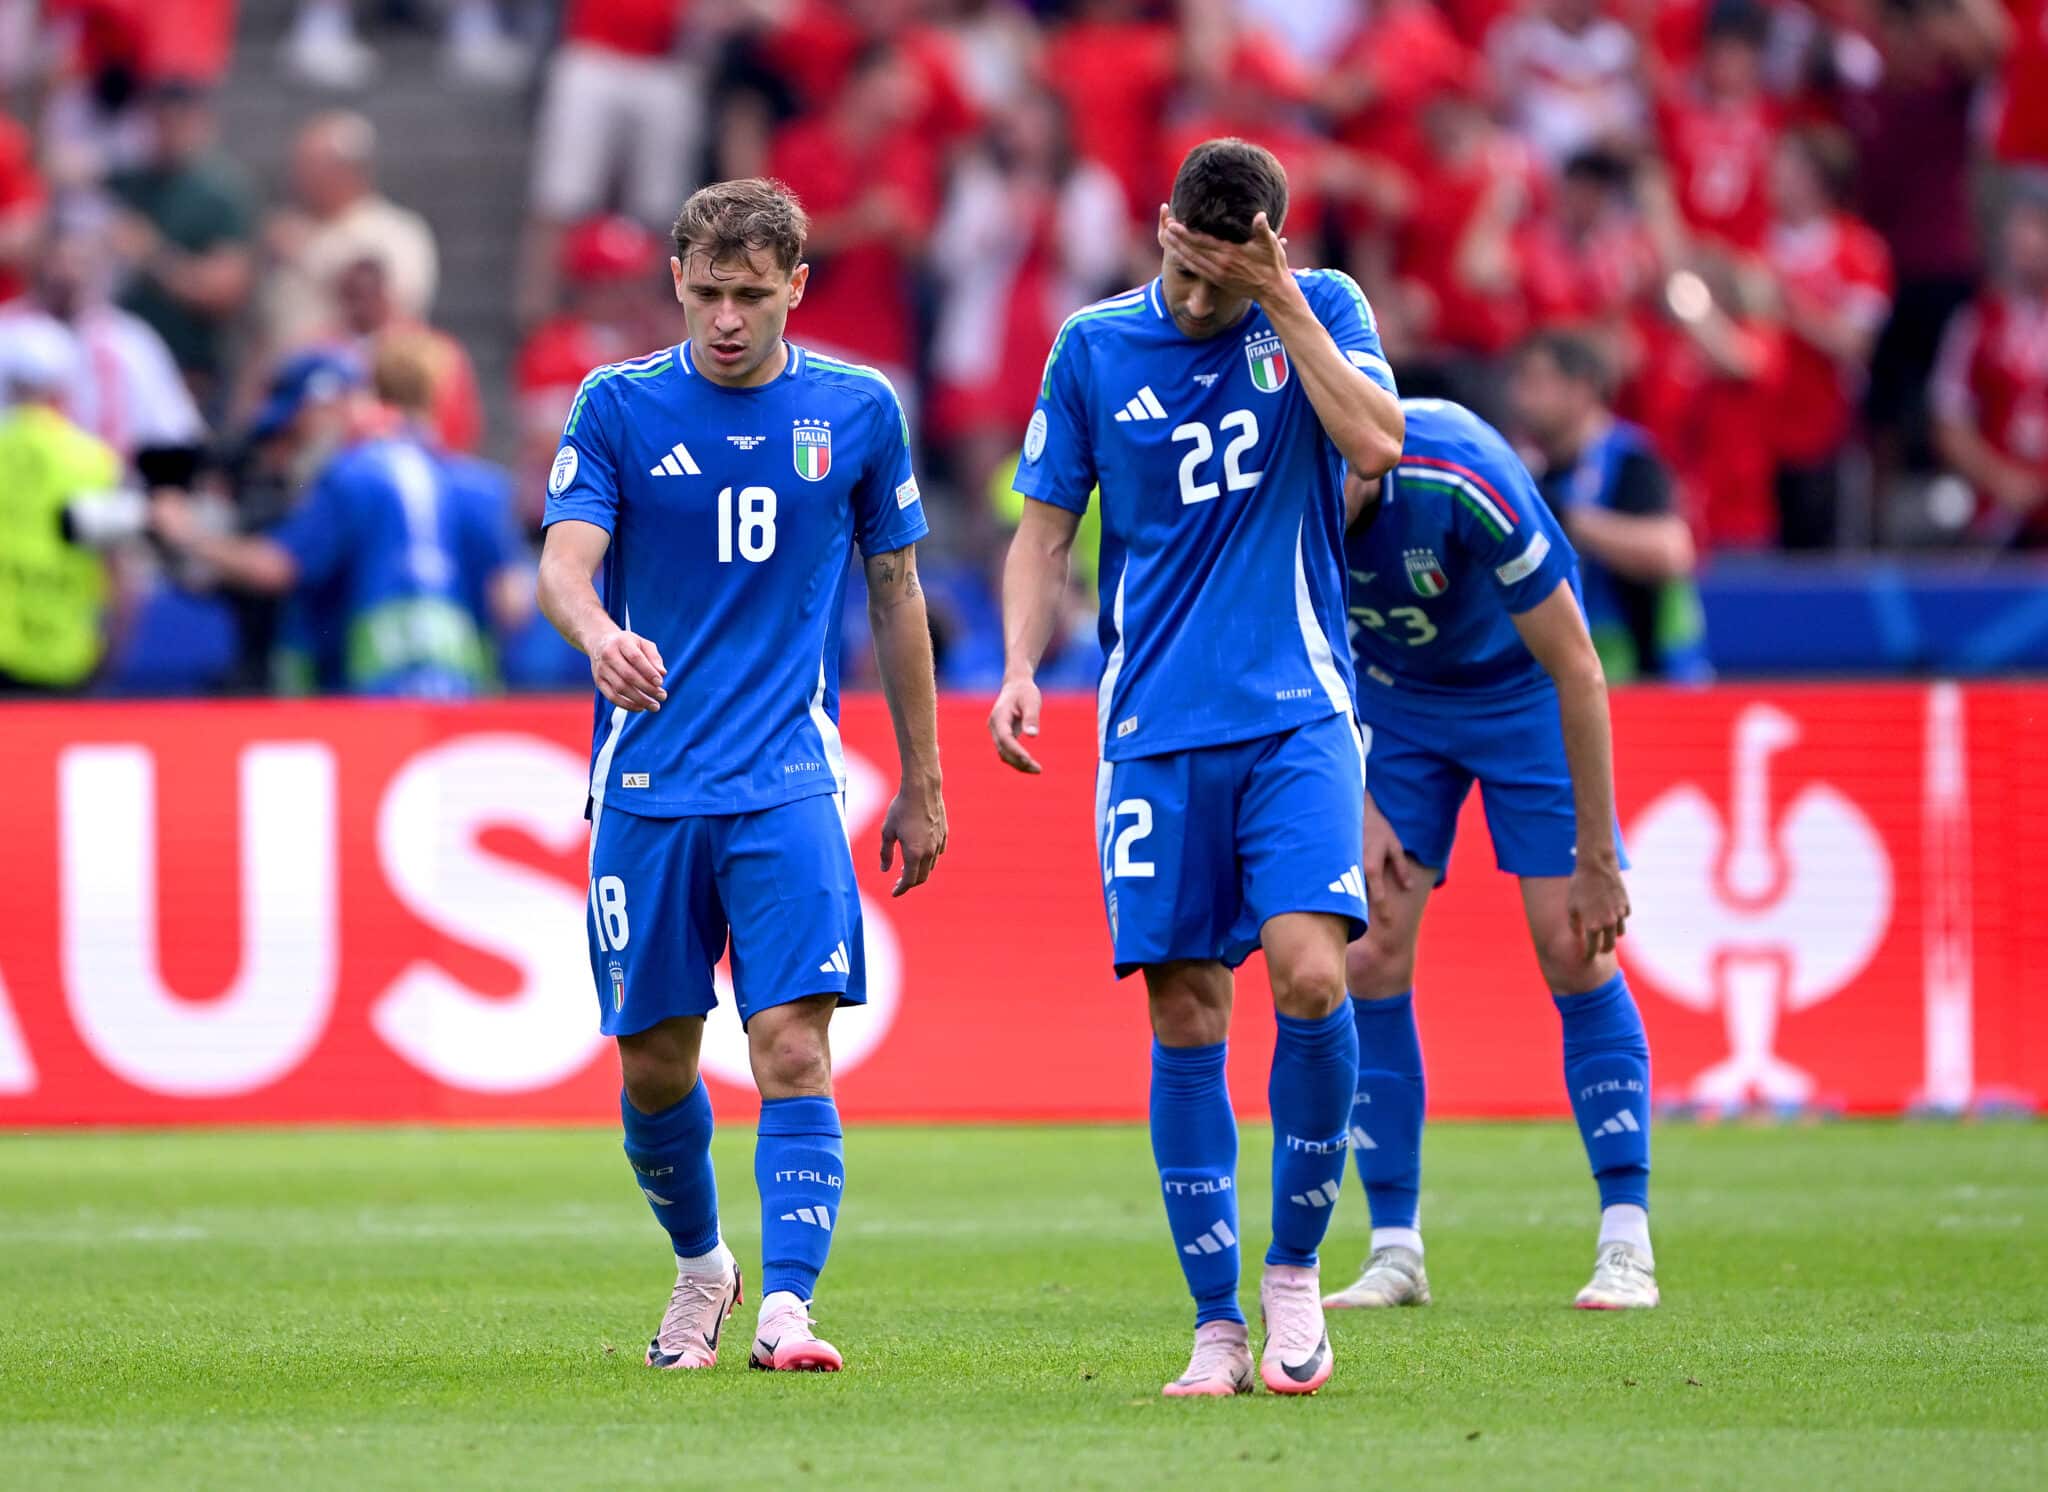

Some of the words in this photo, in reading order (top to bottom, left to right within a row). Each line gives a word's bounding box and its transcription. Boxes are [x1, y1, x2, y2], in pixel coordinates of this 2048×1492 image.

[1250, 340, 1281, 359] ITALIA
[796, 431, 828, 443] ITALIA
[1171, 408, 1265, 505] 22
[718, 486, 777, 563] 18
[1103, 798, 1156, 887] 22
[0, 731, 903, 1096] US
[590, 874, 630, 952] 18
[1581, 1079, 1645, 1102] ITALIA
[1287, 1134, 1350, 1154] ITALIA
[775, 1170, 842, 1191] ITALIA
[1165, 1175, 1232, 1196] ITALIA
